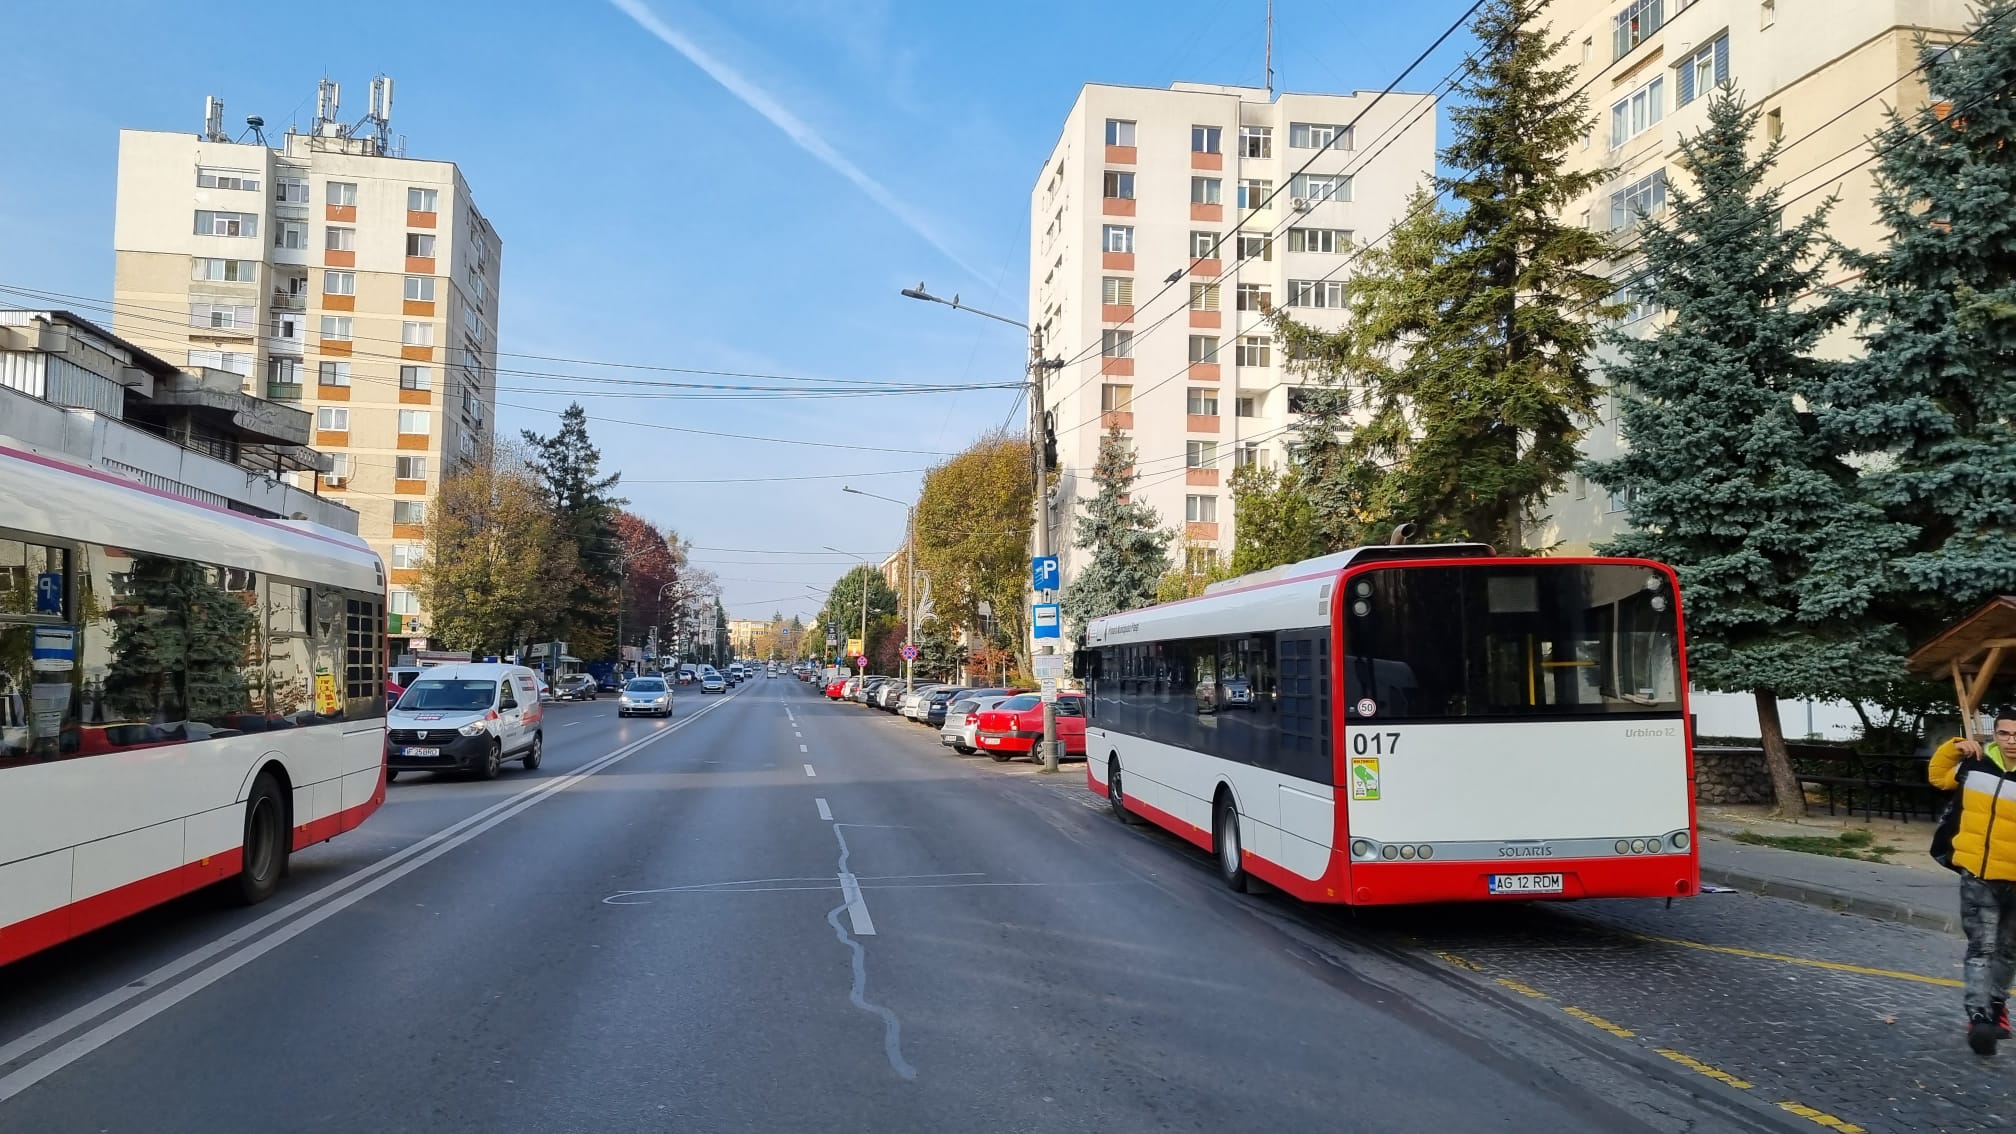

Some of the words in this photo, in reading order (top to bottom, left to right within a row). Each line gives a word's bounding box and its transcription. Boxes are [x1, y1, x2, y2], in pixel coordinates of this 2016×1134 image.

[1043, 560, 1057, 580] P
[1361, 703, 1373, 712] 50
[1625, 728, 1663, 738] Urbino
[1665, 727, 1676, 737] 12
[1353, 732, 1401, 755] 017
[1498, 846, 1553, 858] SOLARIS
[1497, 876, 1513, 889] AG
[1517, 876, 1529, 889] 12
[1533, 875, 1560, 888] RDM
